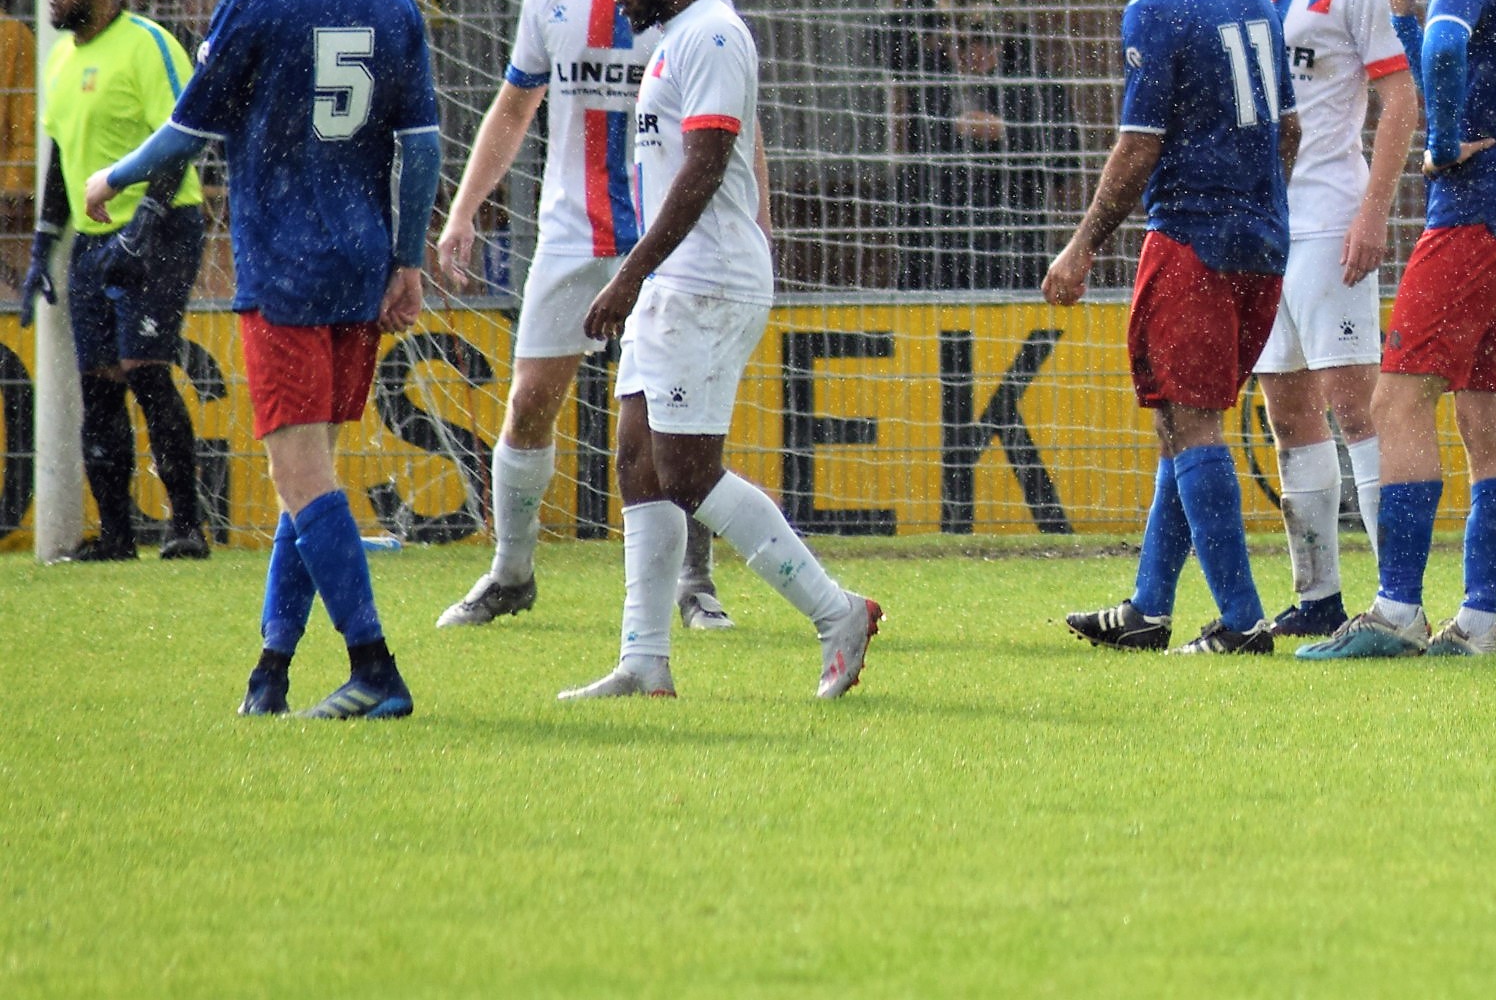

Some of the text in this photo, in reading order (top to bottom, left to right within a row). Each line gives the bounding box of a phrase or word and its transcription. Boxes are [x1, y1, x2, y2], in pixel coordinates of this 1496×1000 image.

[312, 27, 375, 141] 5
[556, 61, 646, 85] LINGE
[1217, 18, 1280, 128] 11
